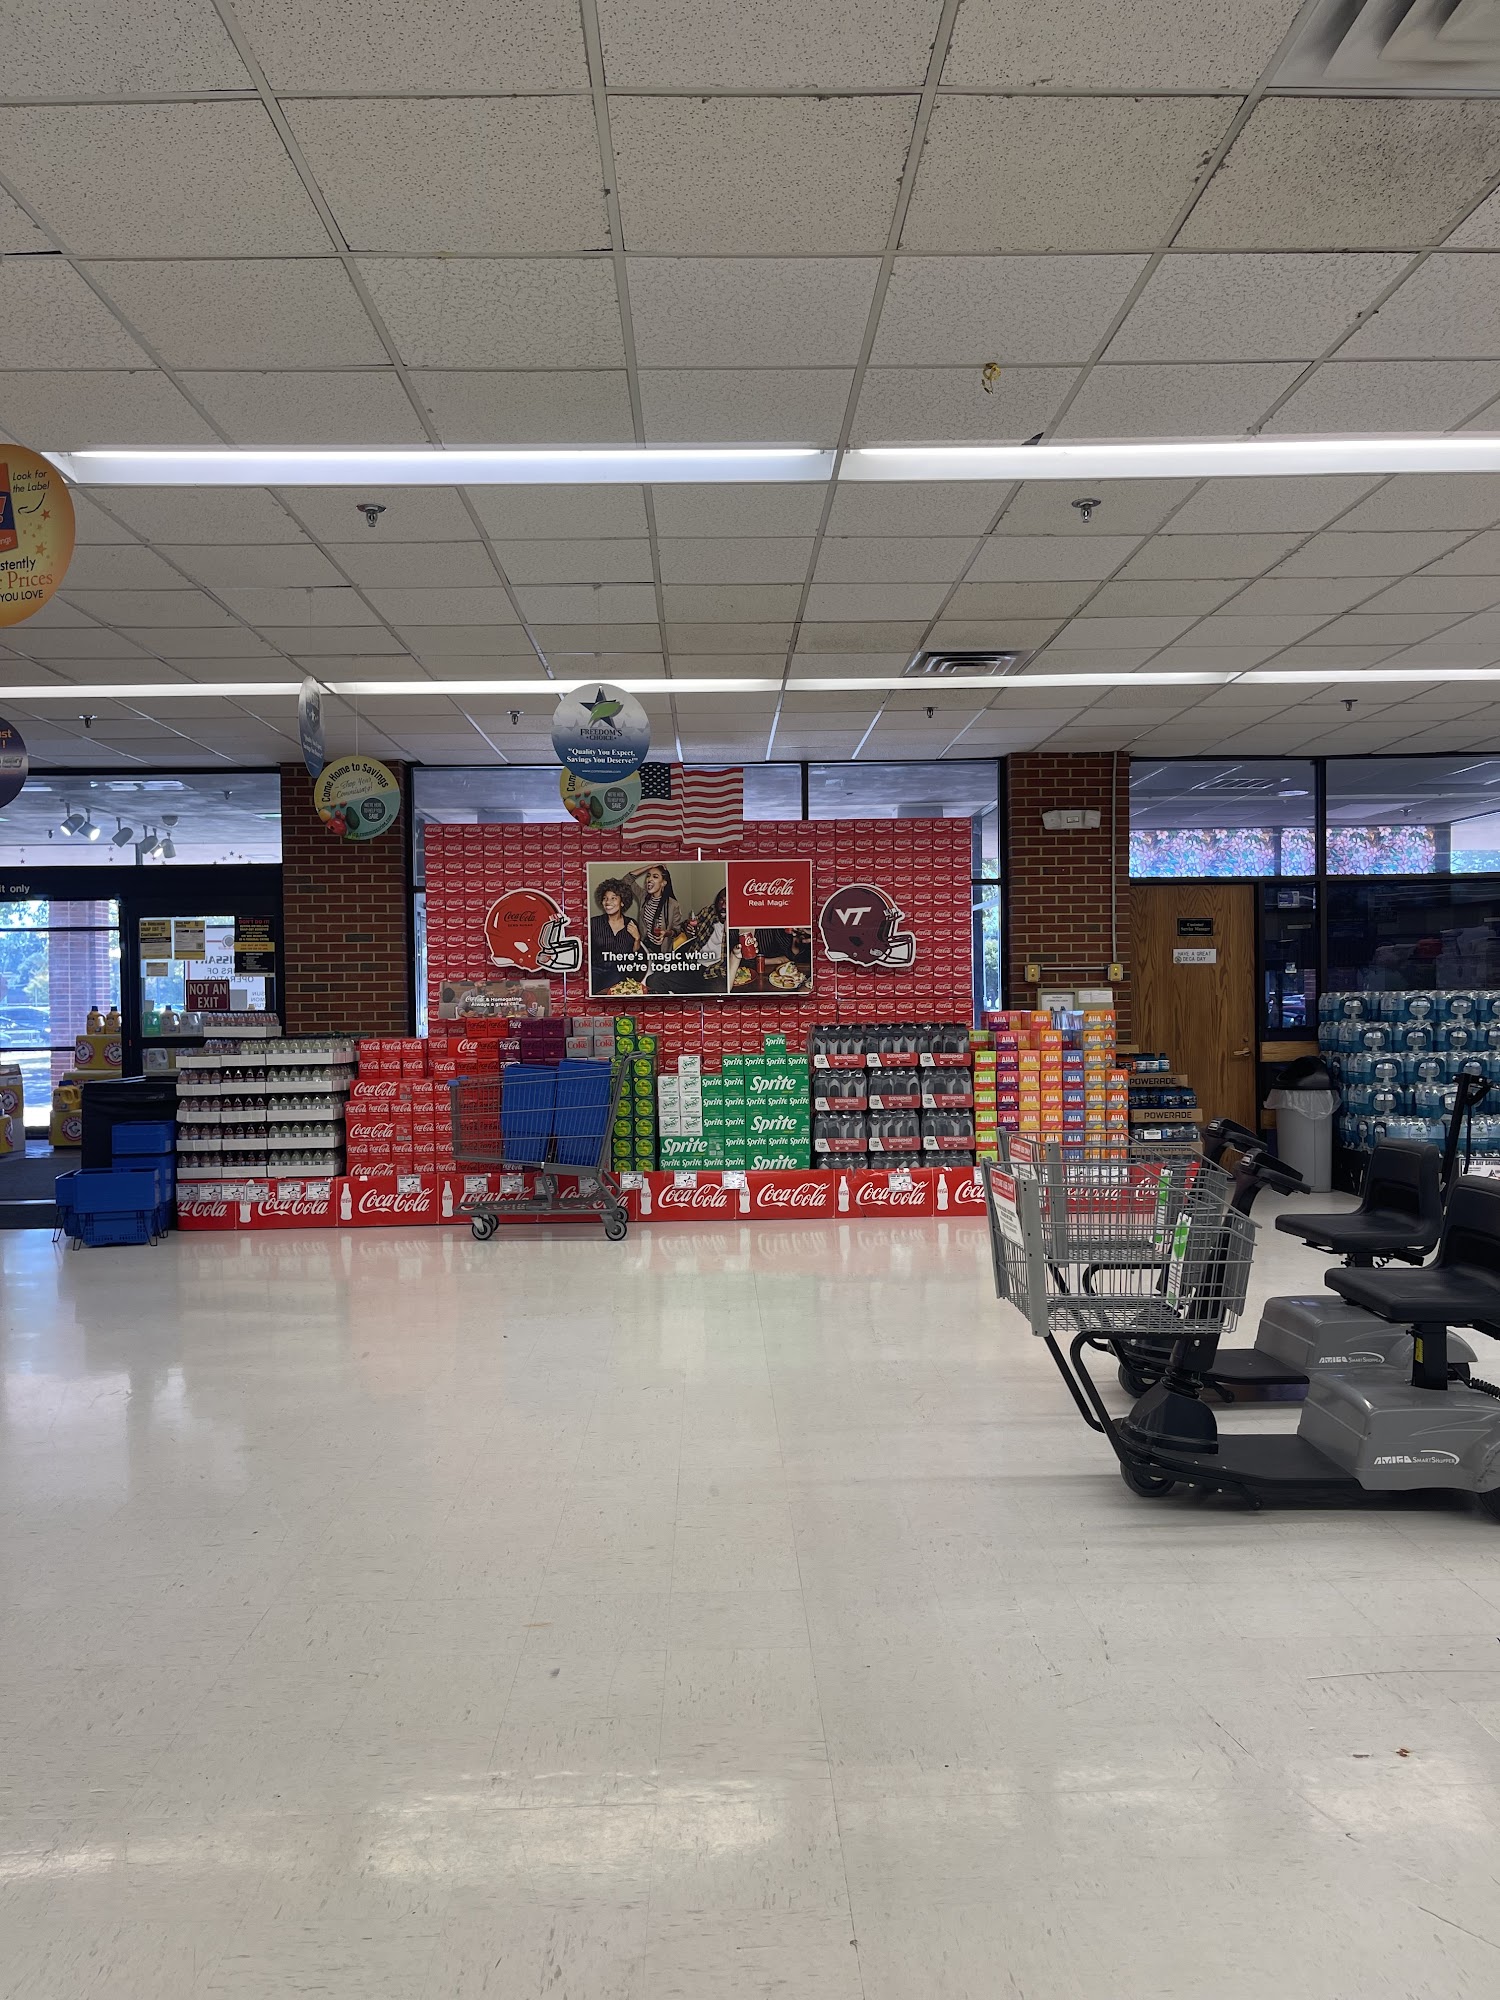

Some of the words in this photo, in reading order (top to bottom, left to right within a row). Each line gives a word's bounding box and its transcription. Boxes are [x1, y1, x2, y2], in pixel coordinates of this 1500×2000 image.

[13, 470, 32, 480] Look
[35, 470, 48, 478] for
[13, 484, 25, 493] the
[28, 481, 50, 492] Label
[8, 570, 53, 589] Prices
[21, 589, 43, 600] LOVE
[580, 728, 623, 736] FREEDOM'S
[567, 756, 592, 764] Savings
[322, 781, 334, 802] Come
[328, 765, 350, 781] Home
[352, 763, 360, 771] to
[362, 764, 389, 788] Savings
[567, 775, 576, 792] Com
[10, 884, 30, 894] only
[742, 877, 796, 896] Coca-Cola
[767, 899, 789, 907] Magic
[835, 907, 872, 926] VT
[602, 951, 644, 962] There's
[647, 951, 682, 963] magic
[685, 950, 716, 960] when
[616, 962, 647, 972] we're
[651, 961, 701, 973] together
[189, 984, 209, 995] NOT
[212, 983, 227, 994] AN
[197, 997, 219, 1008] EXIT
[574, 1020, 592, 1028] Coke
[594, 1020, 613, 1028] Coke
[568, 1040, 587, 1049] Coke
[596, 1039, 614, 1047] Coke
[766, 1038, 785, 1046] Sprite
[723, 1058, 743, 1067] Sprite
[745, 1058, 764, 1066] Sprite
[766, 1058, 786, 1066] Sprite
[788, 1057, 808, 1066] Sprite
[354, 1082, 399, 1096] Coca-Cola
[750, 1075, 796, 1094] Sprite
[703, 1098, 722, 1107] Sprite
[789, 1096, 809, 1106] Sprite
[751, 1115, 797, 1133] Sprite
[350, 1123, 396, 1138] Coca-Cola
[662, 1137, 708, 1156] Sprite
[768, 1137, 788, 1146] Sprite
[661, 1158, 680, 1167] Sprite
[725, 1157, 745, 1166] Sprite
[751, 1155, 797, 1170] Sprite
[658, 1183, 728, 1208] Coca-Cola
[756, 1182, 830, 1207] Coca-Cola
[856, 1181, 930, 1207] Coca-Cola
[358, 1188, 434, 1214] Coca-Cola
[1374, 1456, 1412, 1464] AMIGA
